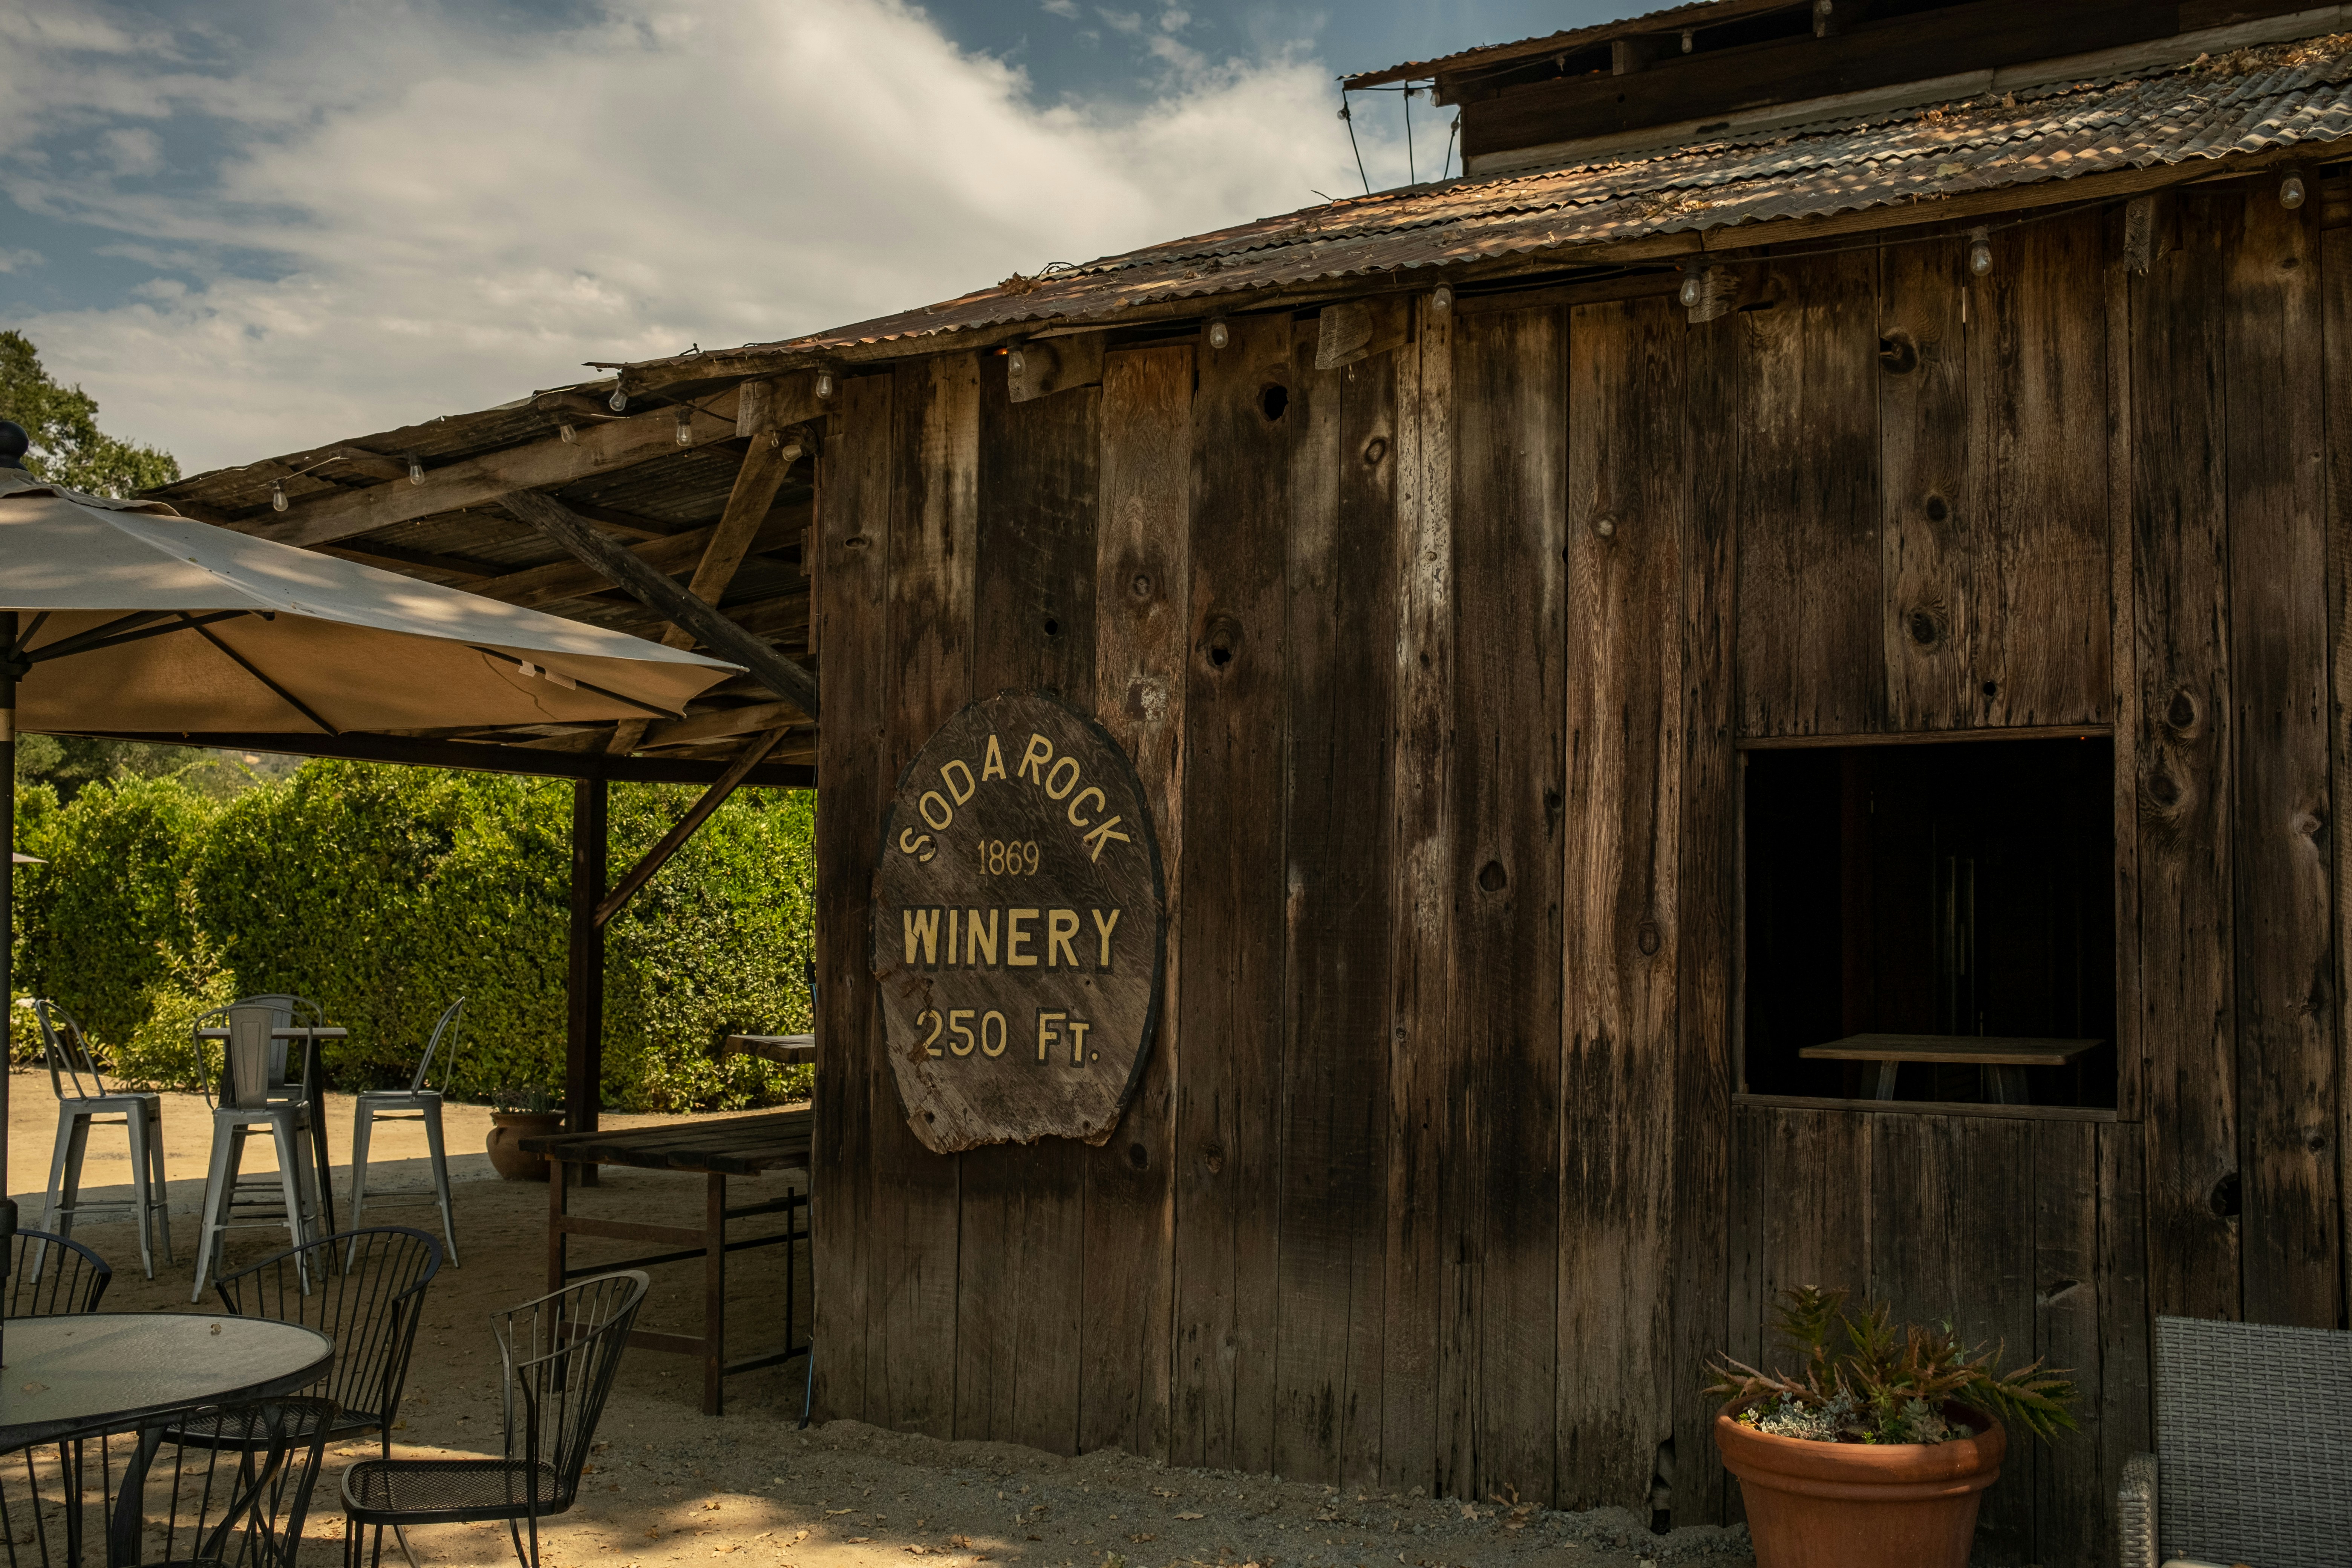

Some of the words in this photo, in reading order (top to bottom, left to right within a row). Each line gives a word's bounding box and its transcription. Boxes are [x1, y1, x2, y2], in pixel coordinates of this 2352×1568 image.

[899, 735, 1006, 862] SODA
[1018, 733, 1131, 863] ROCK
[978, 840, 1039, 875] 1869
[903, 909, 1121, 966] WINERY
[917, 1010, 1007, 1057] 250
